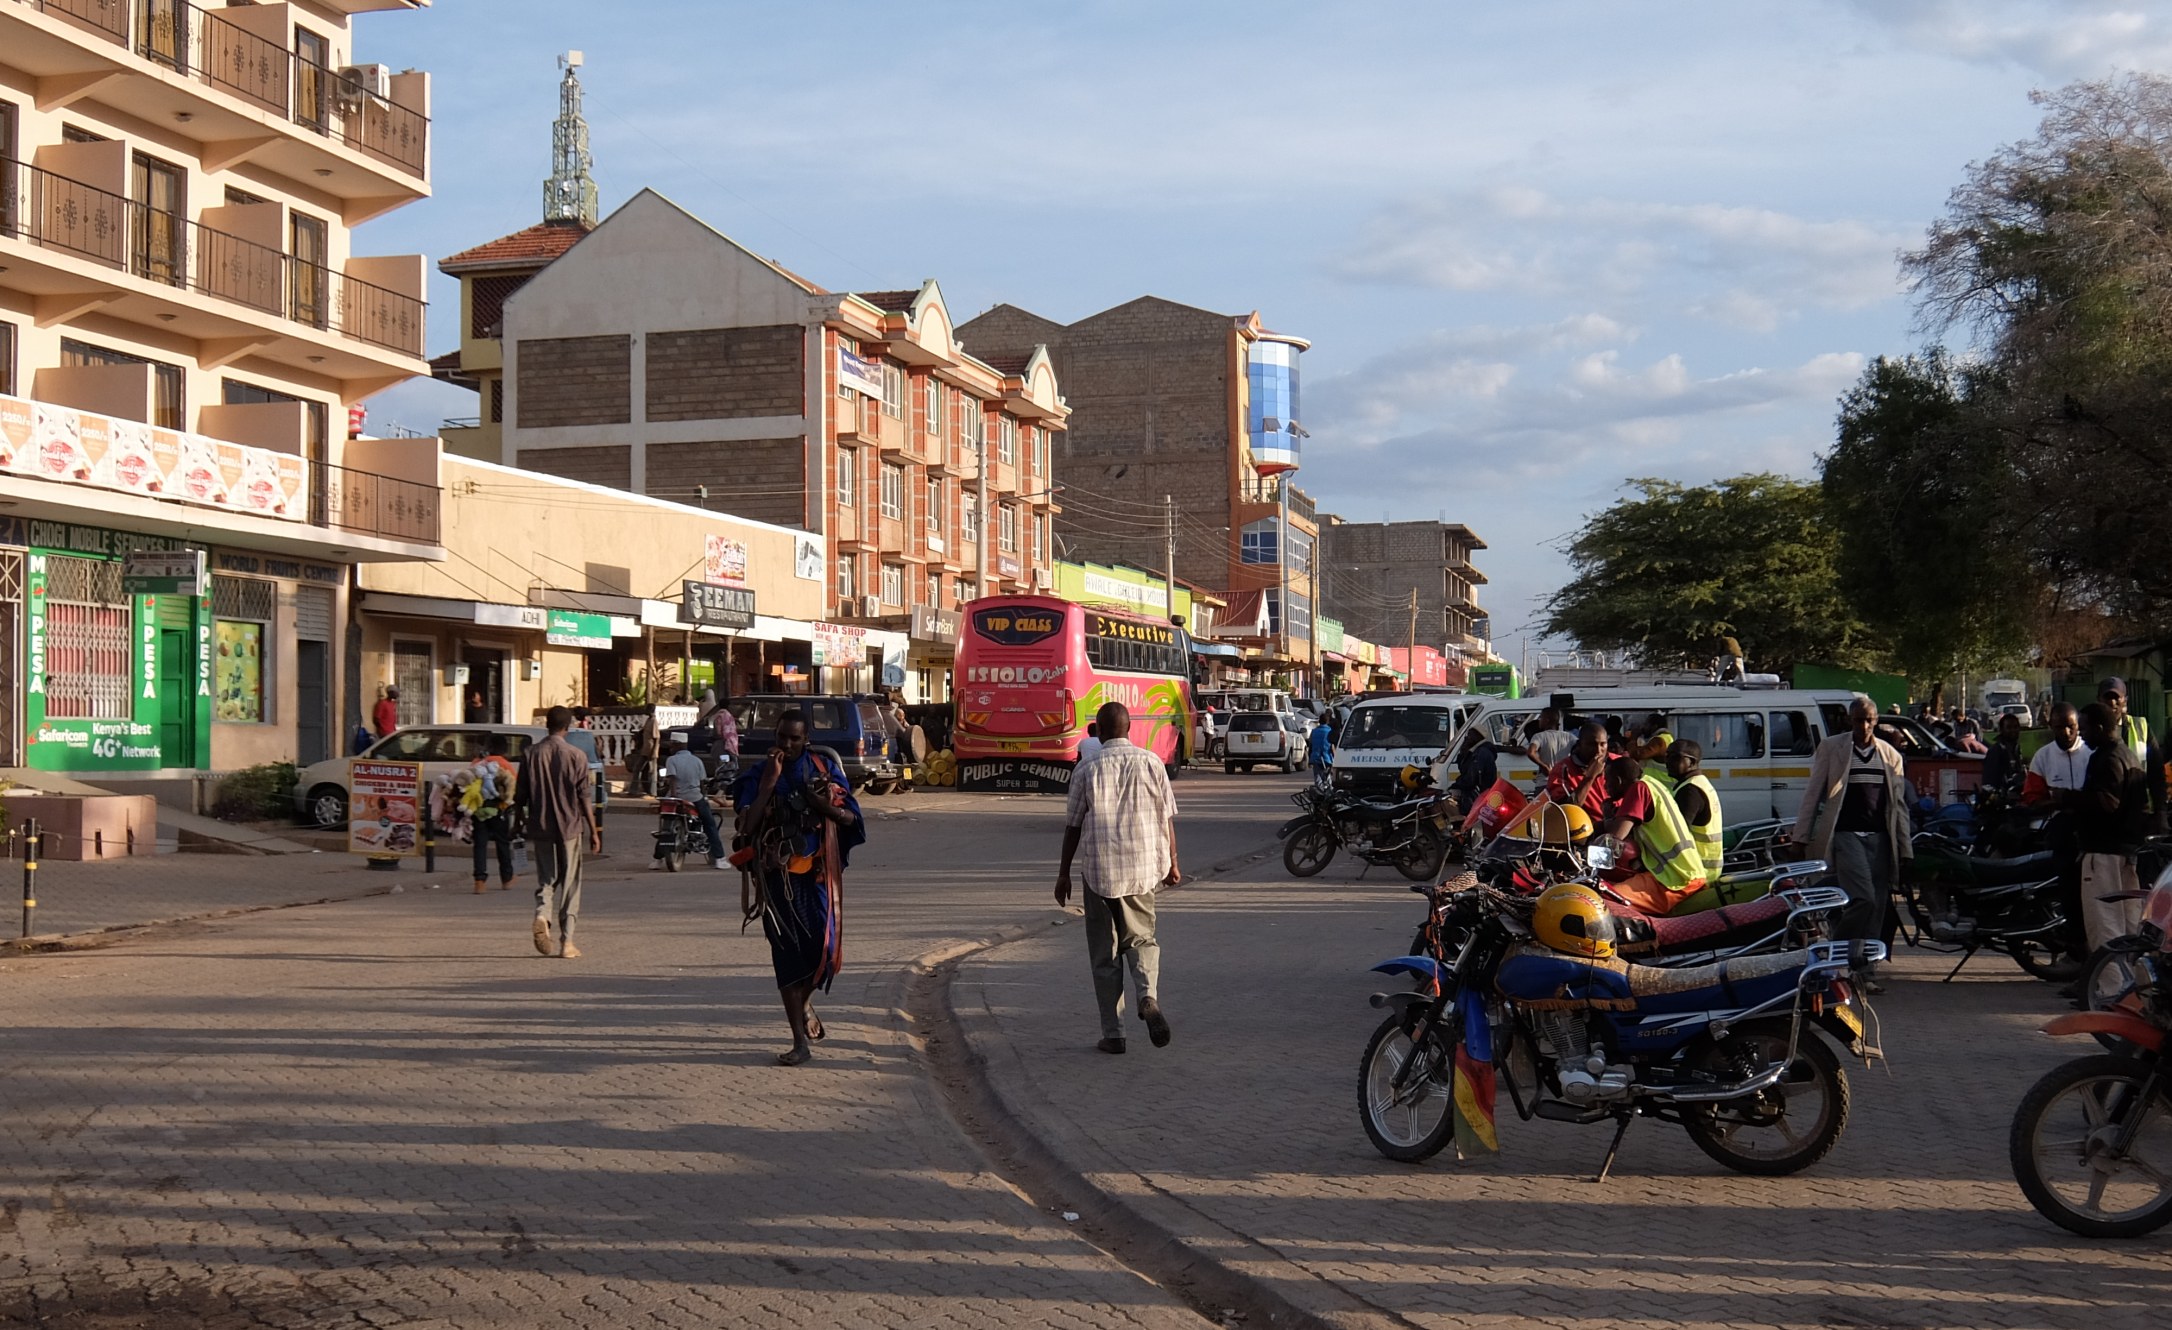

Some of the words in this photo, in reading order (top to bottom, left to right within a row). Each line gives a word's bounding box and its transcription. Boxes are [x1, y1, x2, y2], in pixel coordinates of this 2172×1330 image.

[30, 520, 65, 548] CHOGI
[70, 526, 110, 554] MOBILE
[219, 554, 259, 572] WORLD
[264, 559, 300, 578] FRUITS
[706, 608, 750, 623] RESTAURANT
[987, 617, 1010, 631] VIP
[814, 622, 839, 634] SAFA
[841, 626, 867, 637] SHOP
[925, 615, 955, 636] SidanBank
[1097, 616, 1174, 645] Executive
[30, 615, 45, 694] PESA
[142, 625, 157, 699] PESA
[198, 625, 211, 697] PESA
[968, 666, 1043, 684] ISIOLO
[38, 728, 89, 743] Safaricom
[92, 722, 129, 737] Kenya's
[130, 723, 153, 736] Best
[122, 745, 161, 758] Network
[353, 765, 407, 777] AL-NUSRA
[409, 767, 417, 777] 2
[963, 762, 1014, 785] PUBLIC
[1020, 762, 1072, 784] DEMAND
[996, 779, 1021, 788] SUPER
